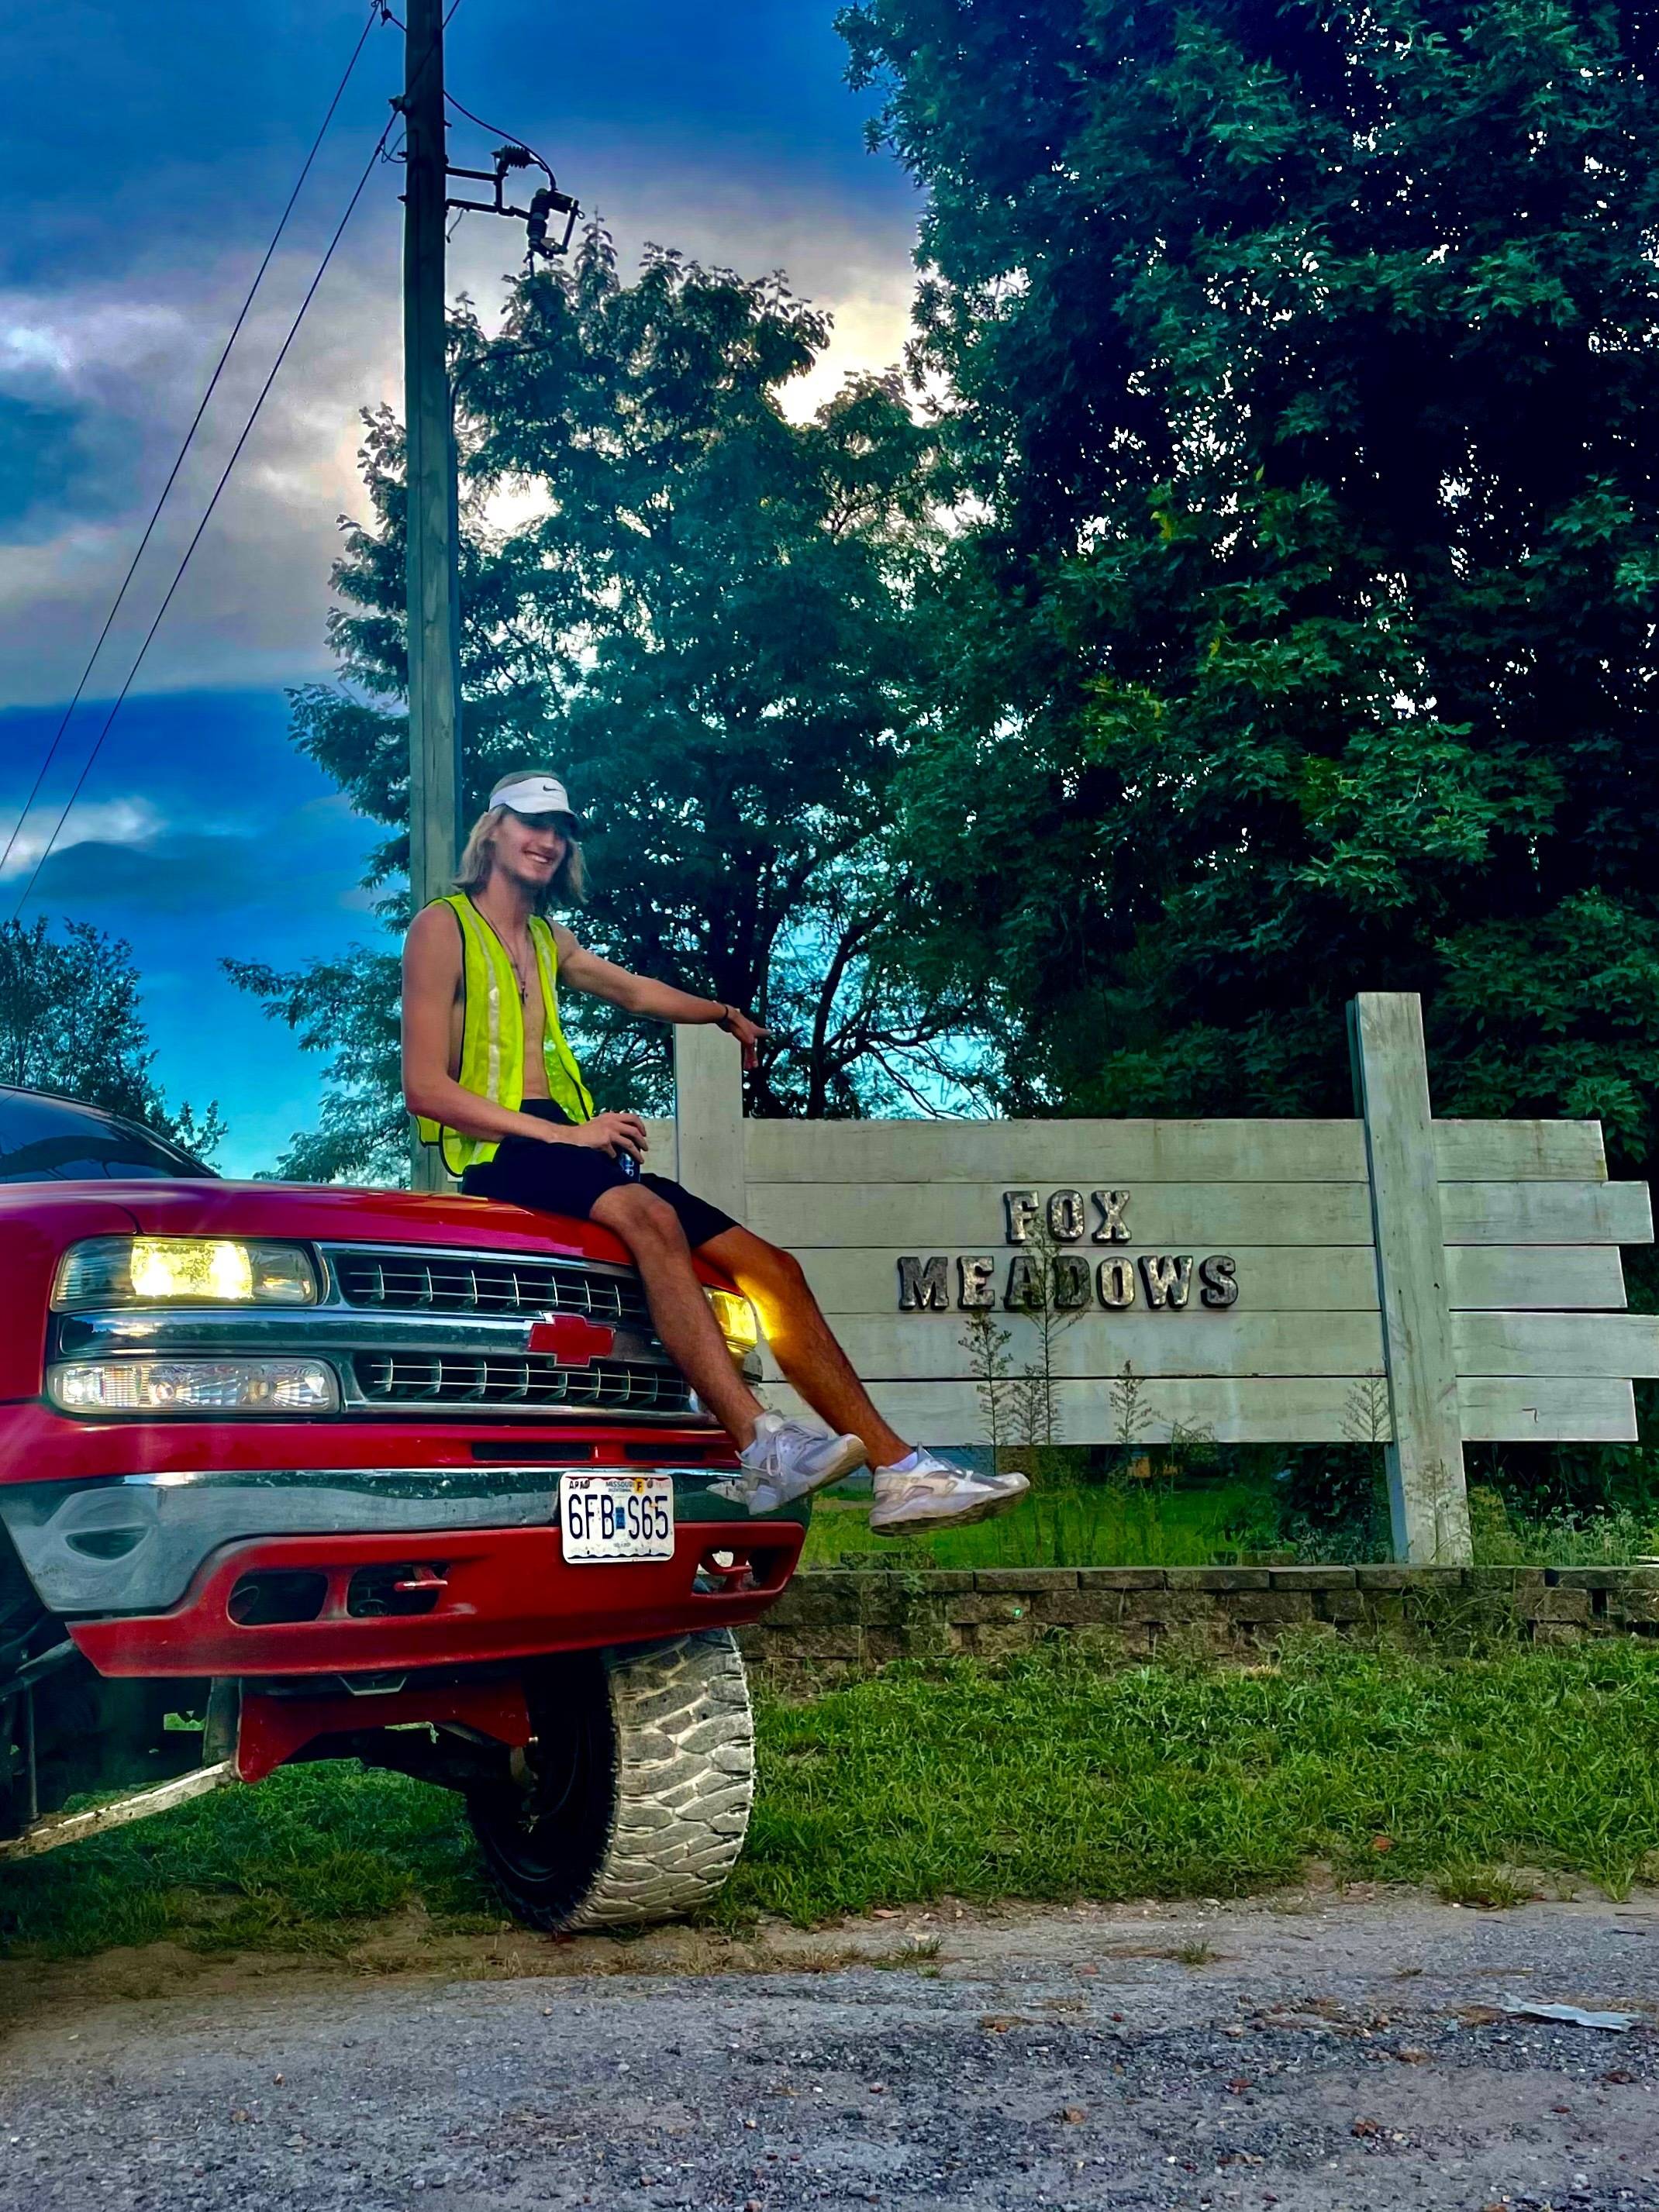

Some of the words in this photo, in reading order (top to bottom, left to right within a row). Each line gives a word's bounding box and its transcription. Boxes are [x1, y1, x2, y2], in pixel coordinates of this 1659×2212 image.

[1003, 1189, 1132, 1244] FOX
[897, 1254, 1239, 1310] MEADOWS
[568, 1494, 615, 1540] 6FB
[627, 1495, 668, 1540] S65
